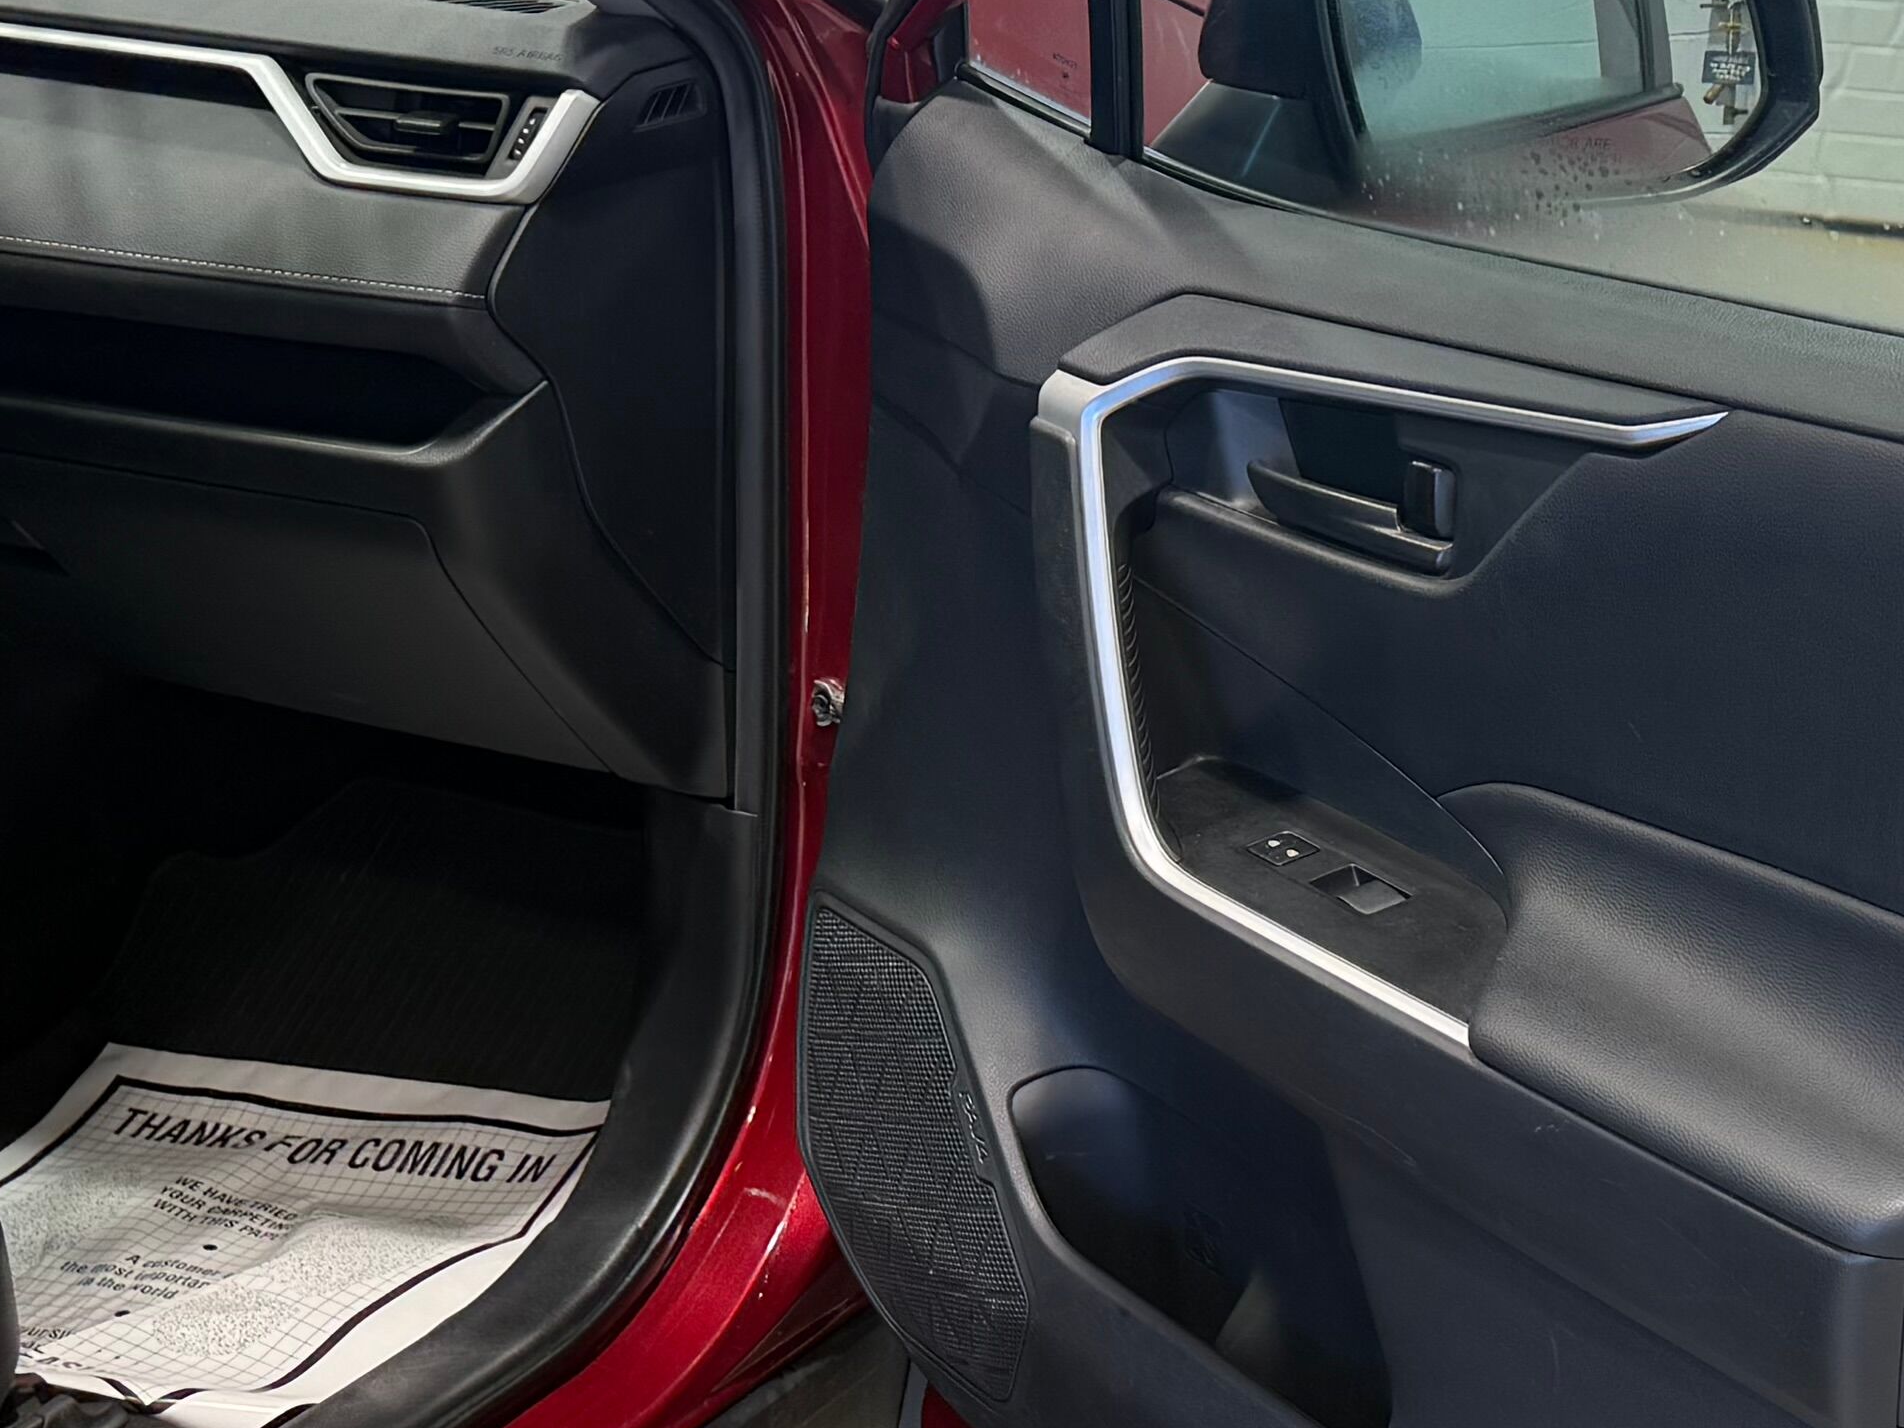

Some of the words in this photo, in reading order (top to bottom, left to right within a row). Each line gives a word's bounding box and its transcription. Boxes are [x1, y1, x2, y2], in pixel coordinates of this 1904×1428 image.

[114, 1107, 267, 1152] THANKS
[264, 1134, 349, 1166] FOR
[348, 1137, 506, 1183] COMING
[505, 1153, 557, 1185] IN
[160, 1186, 207, 1211] YOUR
[175, 1175, 205, 1192] WE
[202, 1187, 249, 1208] HAVE
[248, 1200, 299, 1221] TRIED
[153, 1198, 198, 1223] WITH
[199, 1215, 240, 1229] THIS
[60, 1261, 89, 1274] the
[90, 1262, 134, 1279] most
[125, 1254, 141, 1265] A
[142, 1258, 223, 1277] customer
[96, 1276, 126, 1292] the
